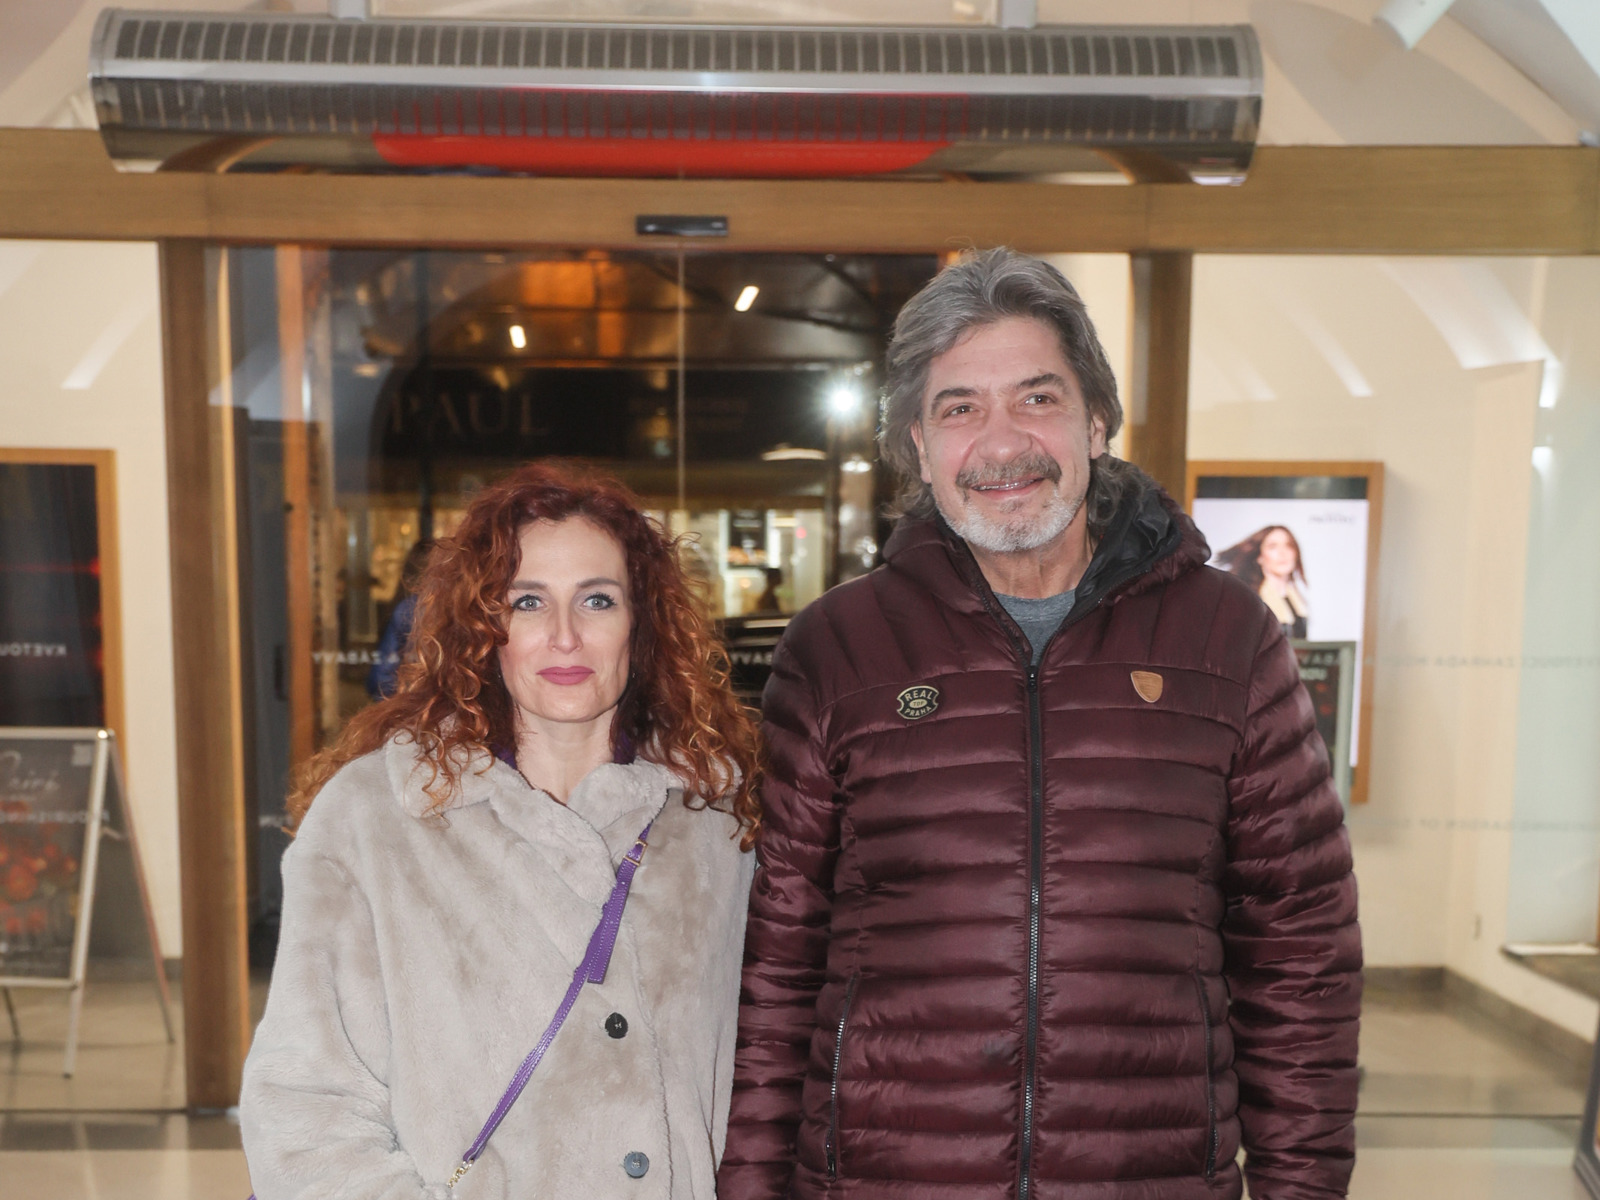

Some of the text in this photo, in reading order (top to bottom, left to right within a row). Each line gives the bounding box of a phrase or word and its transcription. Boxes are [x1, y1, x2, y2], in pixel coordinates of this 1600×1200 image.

[389, 392, 551, 437] PAUL
[904, 689, 933, 701] REAL
[904, 706, 932, 716] PRAHA
